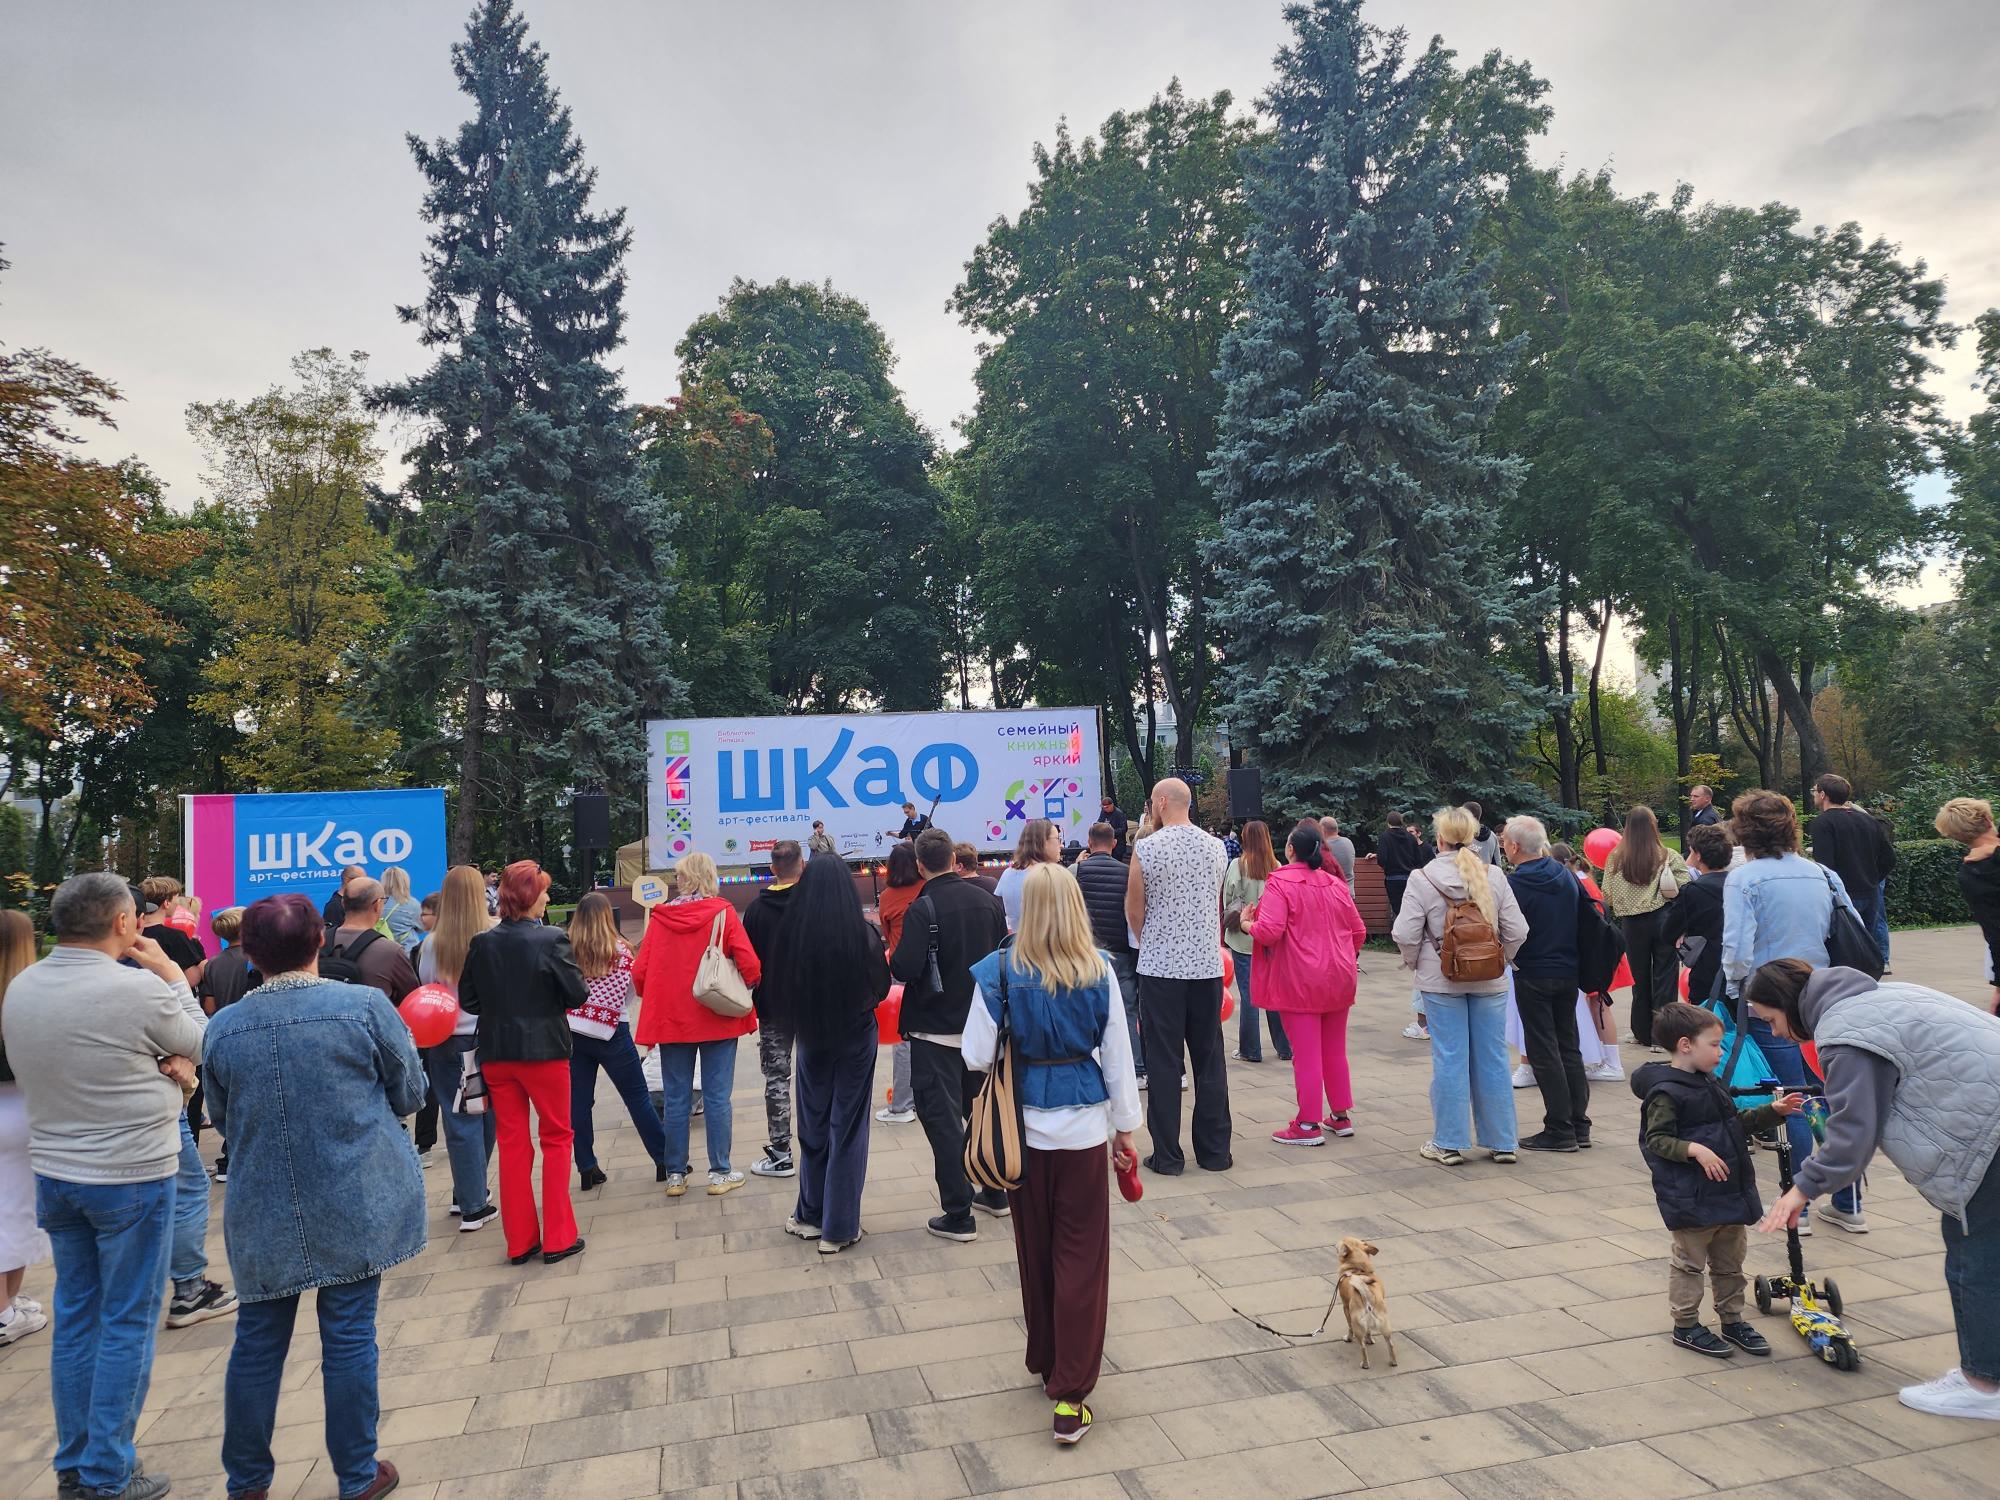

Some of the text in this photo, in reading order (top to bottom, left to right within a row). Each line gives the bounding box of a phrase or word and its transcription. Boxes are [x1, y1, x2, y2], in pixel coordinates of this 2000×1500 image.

[997, 722, 1079, 736] семейный
[1007, 736, 1080, 752] книжный
[1033, 752, 1081, 767] яркий
[718, 813, 811, 827] арт-фестиваль
[249, 869, 344, 883] арт-фестивал
